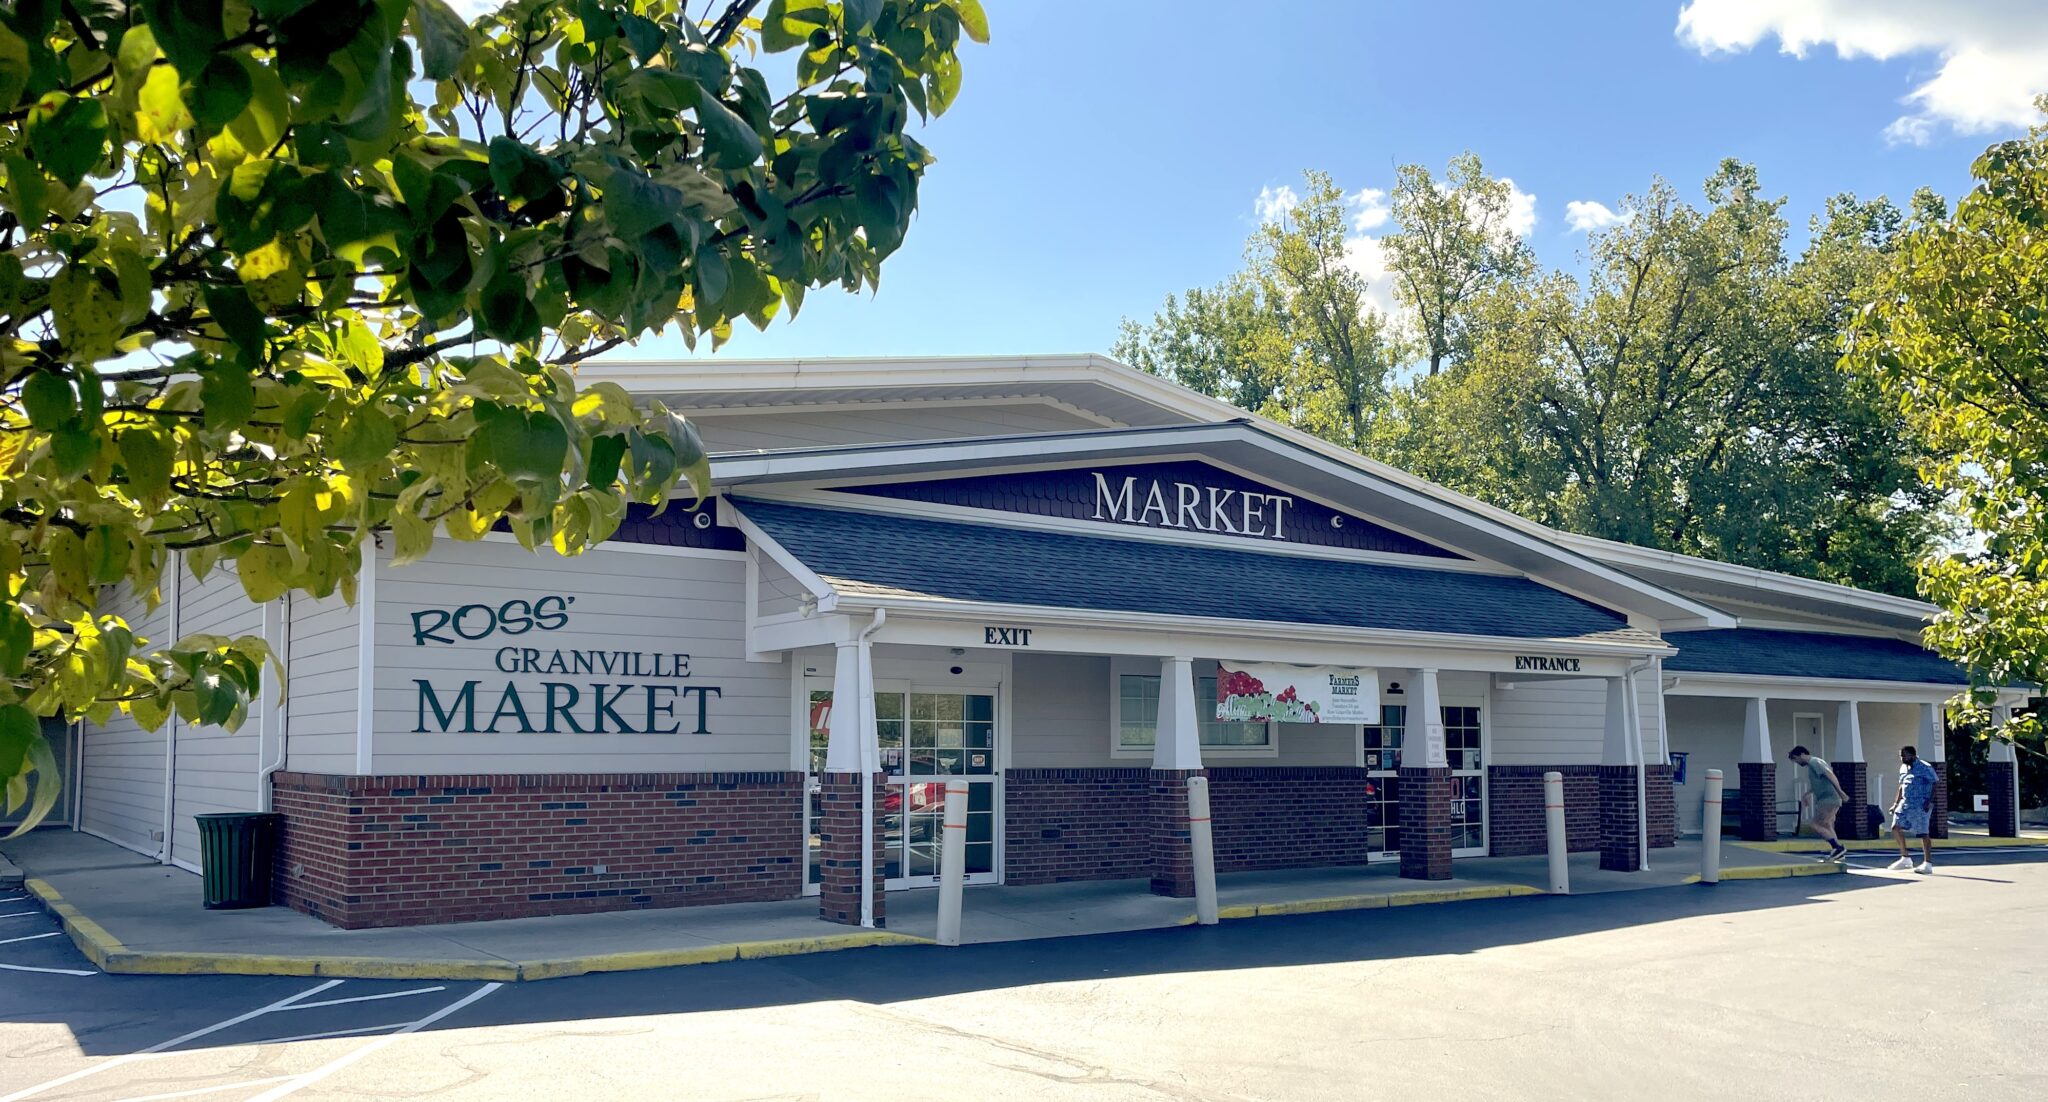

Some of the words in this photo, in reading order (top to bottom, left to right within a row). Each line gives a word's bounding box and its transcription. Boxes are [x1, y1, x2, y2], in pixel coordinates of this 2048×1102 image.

[1091, 472, 1293, 539] MARKET
[411, 595, 575, 645] ROSS'
[984, 626, 1032, 646] EXIT
[495, 646, 691, 678] GRANVILLE
[1515, 656, 1580, 671] ENTRANCE
[1329, 673, 1360, 687] FARMERS
[1331, 686, 1358, 695] MARKET
[410, 679, 721, 735] MARKET
